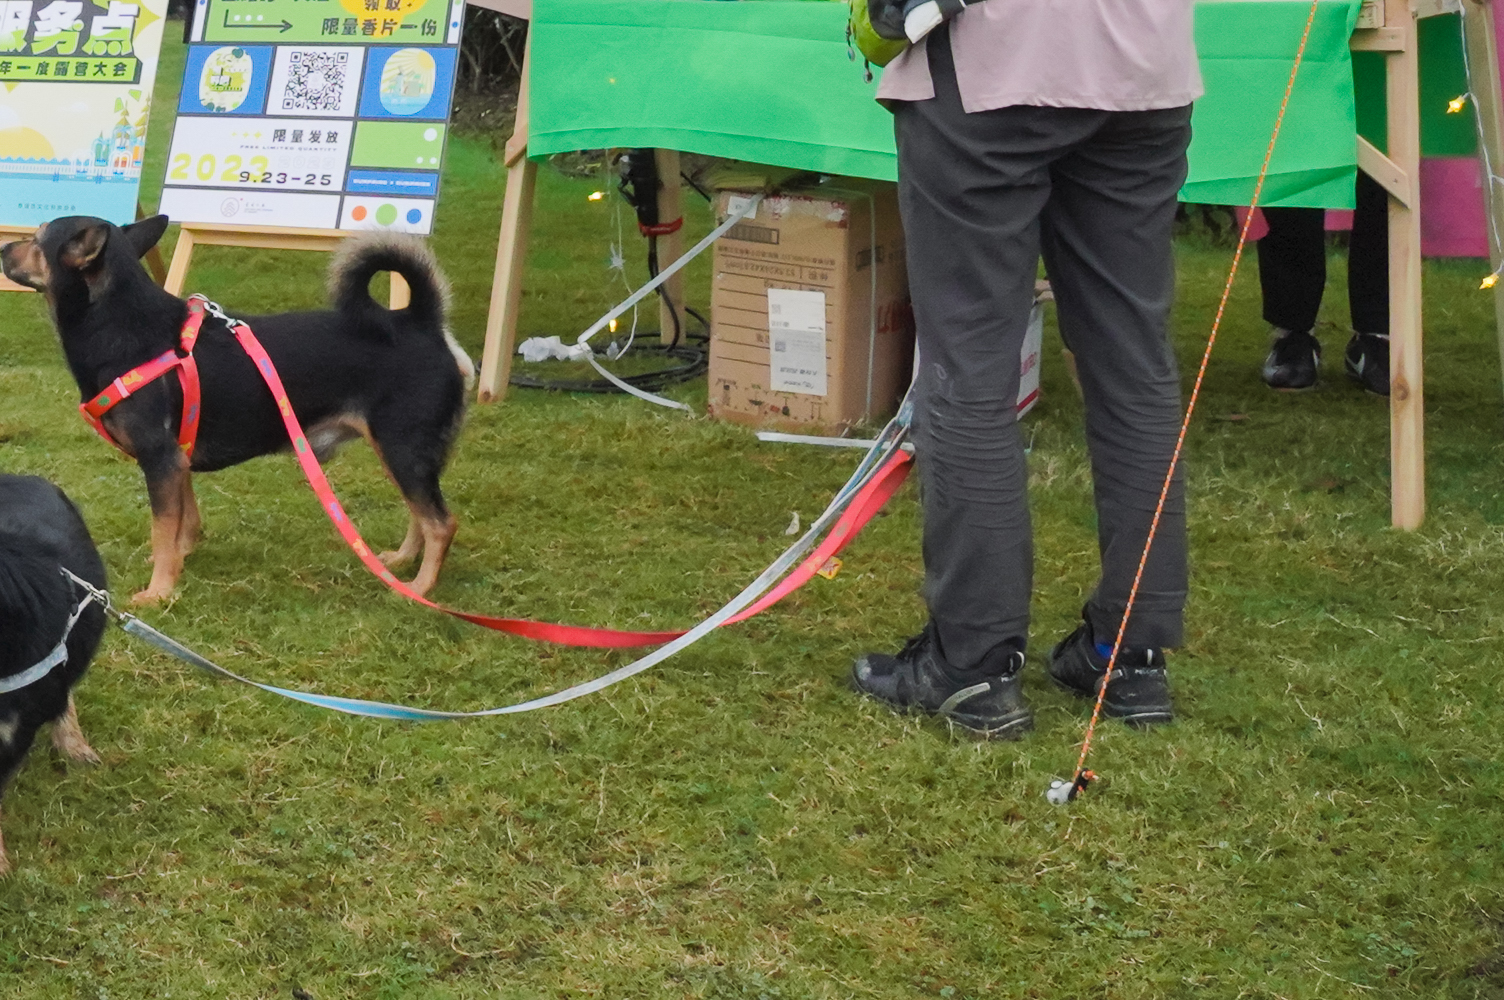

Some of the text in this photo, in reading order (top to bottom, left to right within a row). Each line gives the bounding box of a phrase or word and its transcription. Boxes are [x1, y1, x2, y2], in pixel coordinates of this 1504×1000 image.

[272, 129, 338, 144] 限量发放
[170, 153, 269, 182] 2023
[239, 171, 332, 186] 9.23-25
